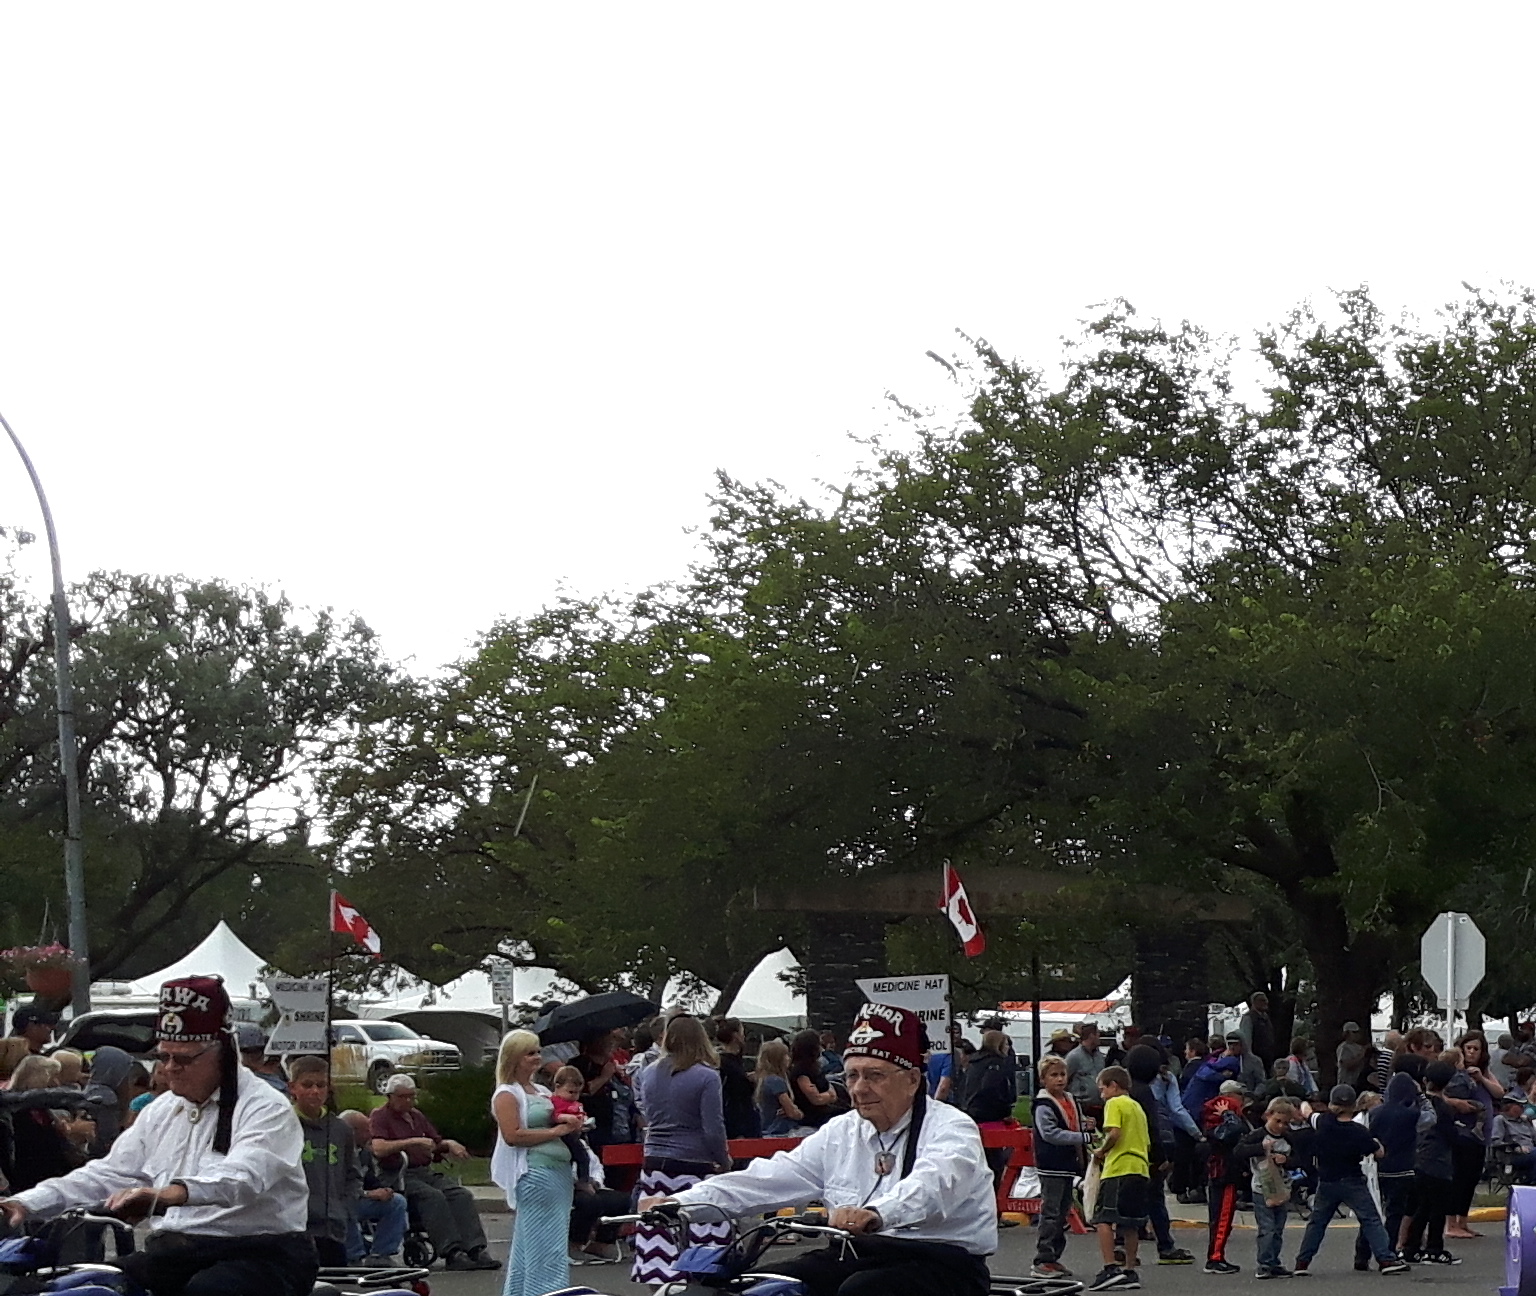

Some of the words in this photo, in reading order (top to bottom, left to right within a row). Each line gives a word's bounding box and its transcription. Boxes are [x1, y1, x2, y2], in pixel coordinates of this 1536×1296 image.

[872, 980, 921, 993] MEDICINE
[924, 979, 945, 990] HAT
[293, 1011, 326, 1022] SHRINE
[915, 1008, 946, 1021] RINE
[929, 1040, 948, 1051] ROL
